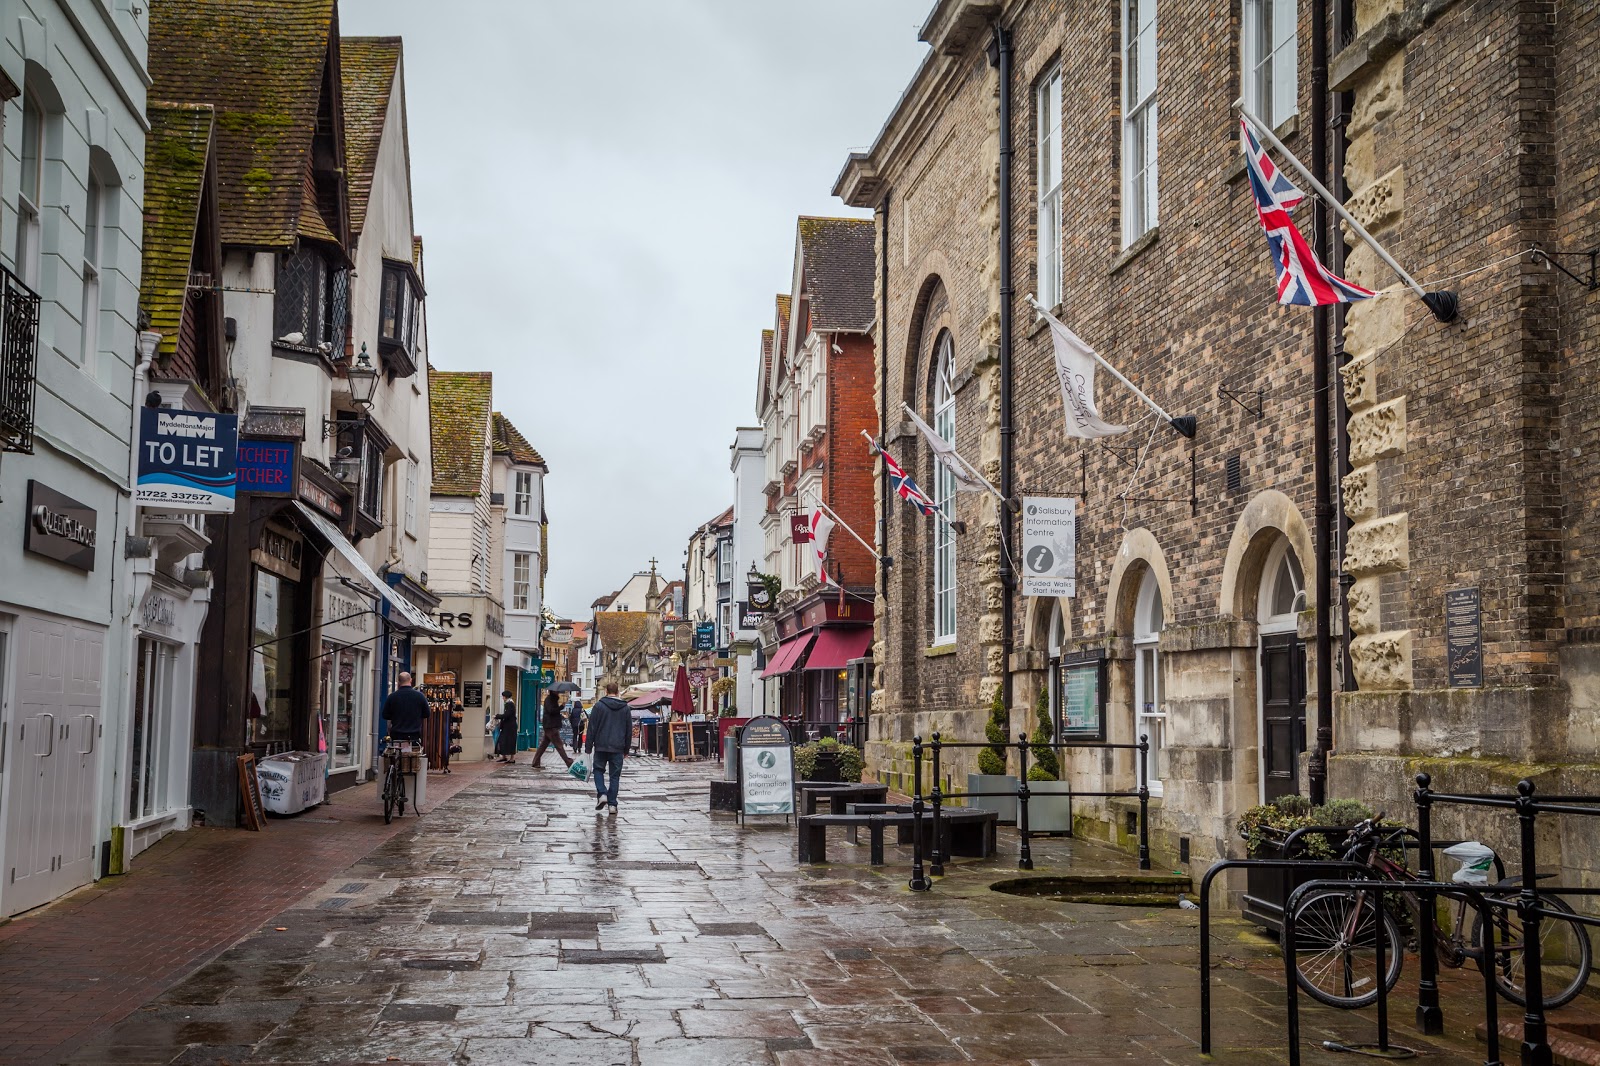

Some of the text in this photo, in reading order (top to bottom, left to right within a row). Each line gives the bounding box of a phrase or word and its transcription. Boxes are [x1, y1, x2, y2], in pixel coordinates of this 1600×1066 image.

[145, 440, 224, 468] TO LET
[238, 447, 289, 464] TCHETT
[171, 492, 212, 500] 337577
[1038, 506, 1072, 516] Salisbury
[1026, 517, 1072, 526] Information
[1026, 528, 1055, 537] Centre
[742, 615, 763, 623] ARMY
[748, 771, 778, 780] Salisbury
[748, 780, 787, 788] Information
